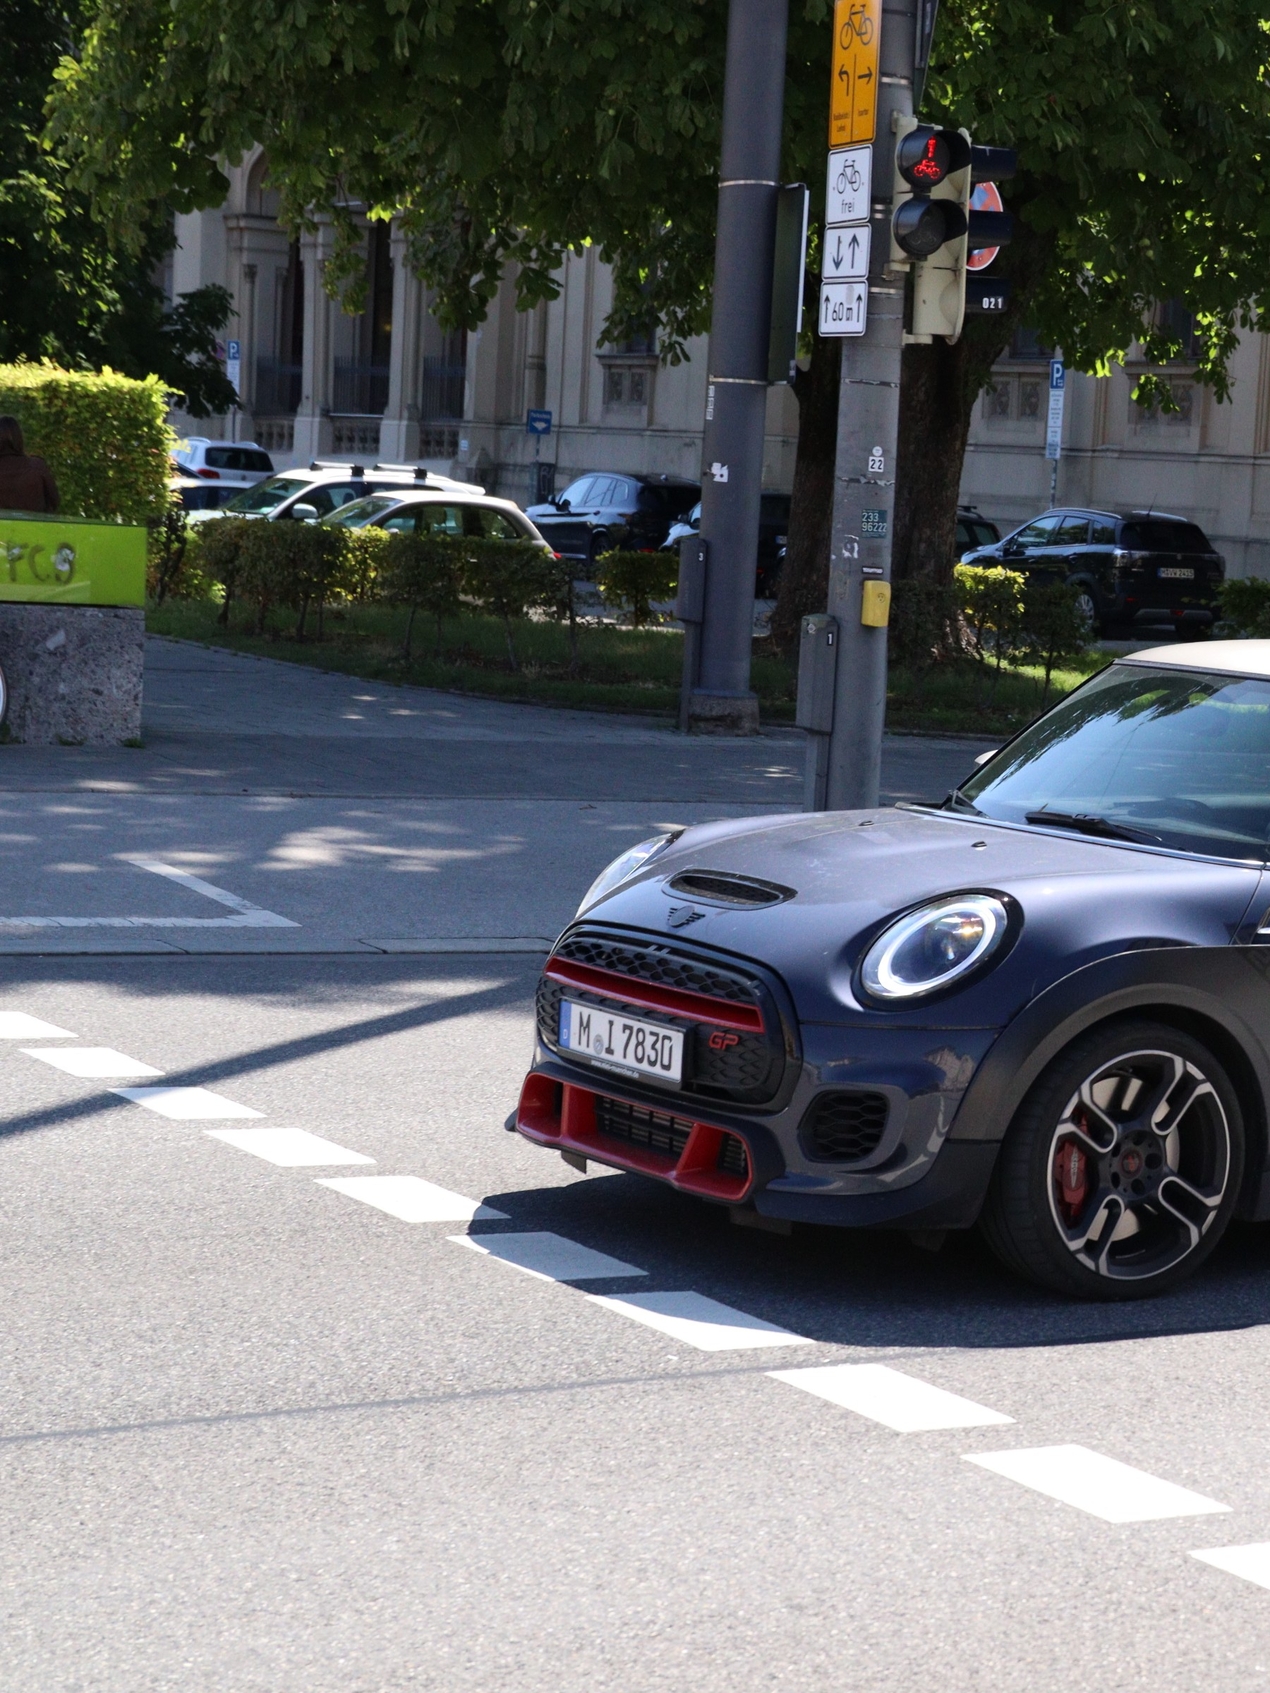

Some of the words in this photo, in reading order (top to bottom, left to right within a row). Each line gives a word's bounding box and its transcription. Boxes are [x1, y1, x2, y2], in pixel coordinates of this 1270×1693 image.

[841, 198, 855, 214] frei
[982, 297, 1002, 309] 021
[831, 302, 844, 321] 60
[230, 342, 238, 359] P
[1053, 363, 1063, 386] P
[870, 459, 883, 470] 22
[862, 512, 879, 522] 233
[698, 552, 704, 562] 3
[827, 633, 833, 645] 1
[578, 1011, 591, 1049] M
[622, 1023, 673, 1072] 7830
[708, 1030, 740, 1051] GP
